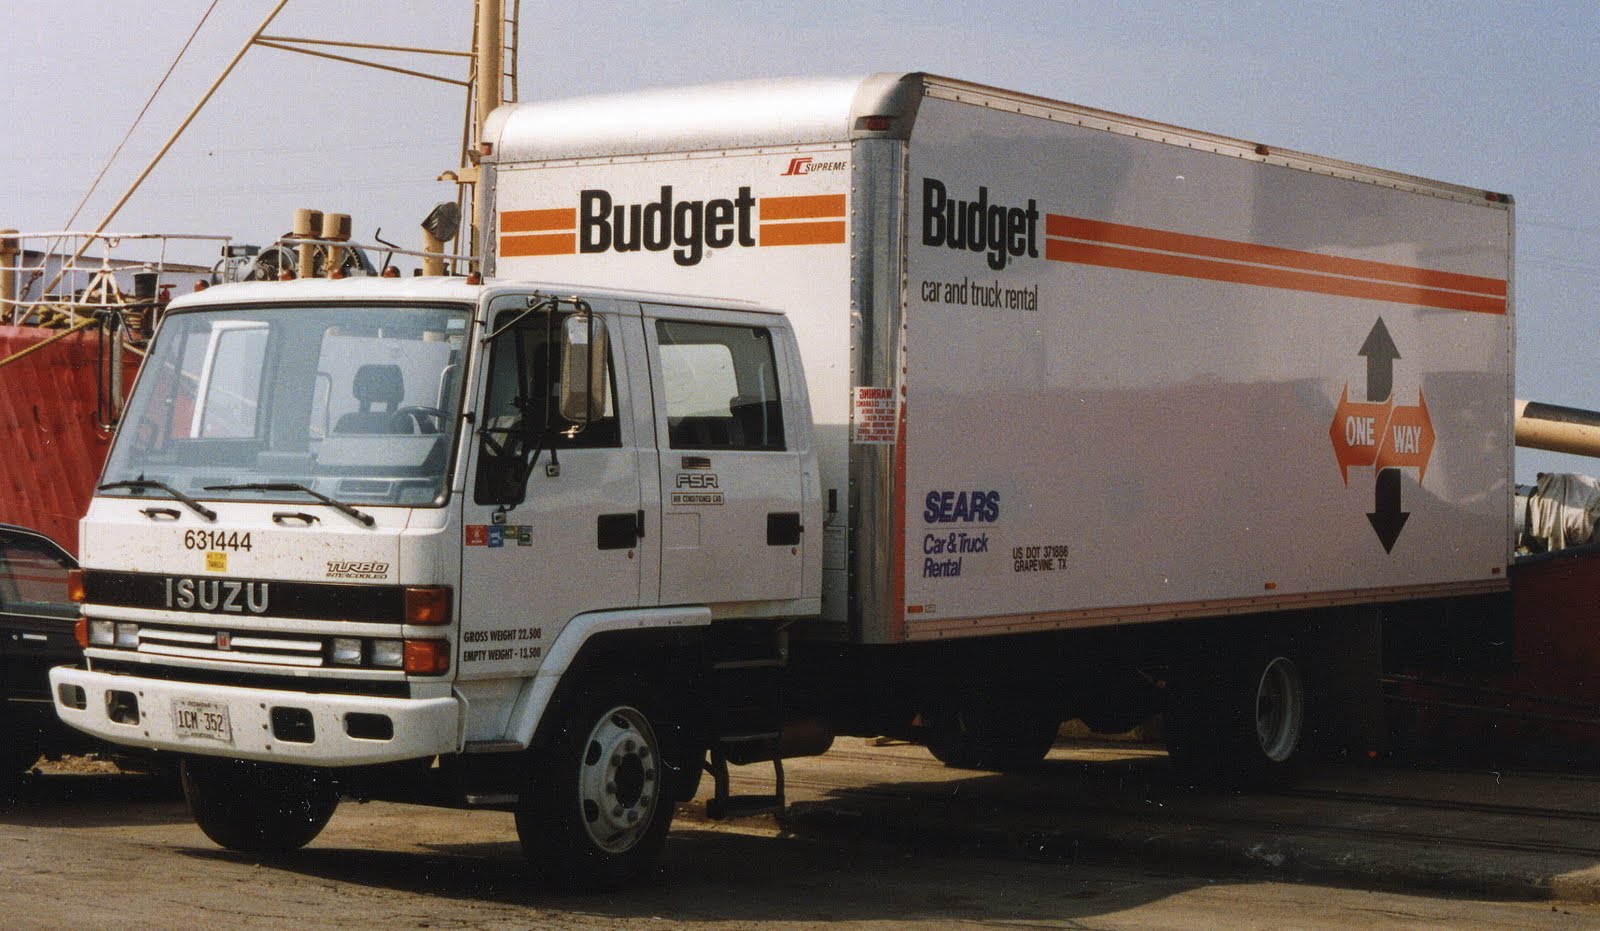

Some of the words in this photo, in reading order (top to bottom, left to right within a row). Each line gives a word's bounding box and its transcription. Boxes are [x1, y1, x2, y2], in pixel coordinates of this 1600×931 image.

[805, 161, 847, 172] SUPREME
[580, 185, 756, 267] Budget
[922, 177, 1039, 271] Budget
[921, 280, 942, 302] car
[944, 276, 968, 305] and
[971, 280, 1002, 308] truck
[1005, 284, 1038, 312] rental
[1345, 415, 1376, 447] ONE
[1392, 425, 1421, 454] WAY
[676, 473, 719, 489] FSR
[924, 490, 1000, 523] SEARS
[184, 529, 252, 552] 631444
[923, 533, 946, 555] Car
[946, 532, 957, 554] &
[958, 532, 989, 554] Truck
[1012, 547, 1024, 560] US
[1026, 546, 1041, 559] DOT
[327, 561, 389, 574] TURBO
[923, 557, 962, 578] Rental
[1057, 558, 1067, 571] TX
[326, 572, 388, 580] INTERCOOLED
[165, 578, 269, 613] ISUZU
[463, 630, 489, 643] GROSS
[490, 629, 517, 641] WEIGHT
[463, 649, 487, 662] EMPTY
[488, 648, 514, 660] WEIGHT
